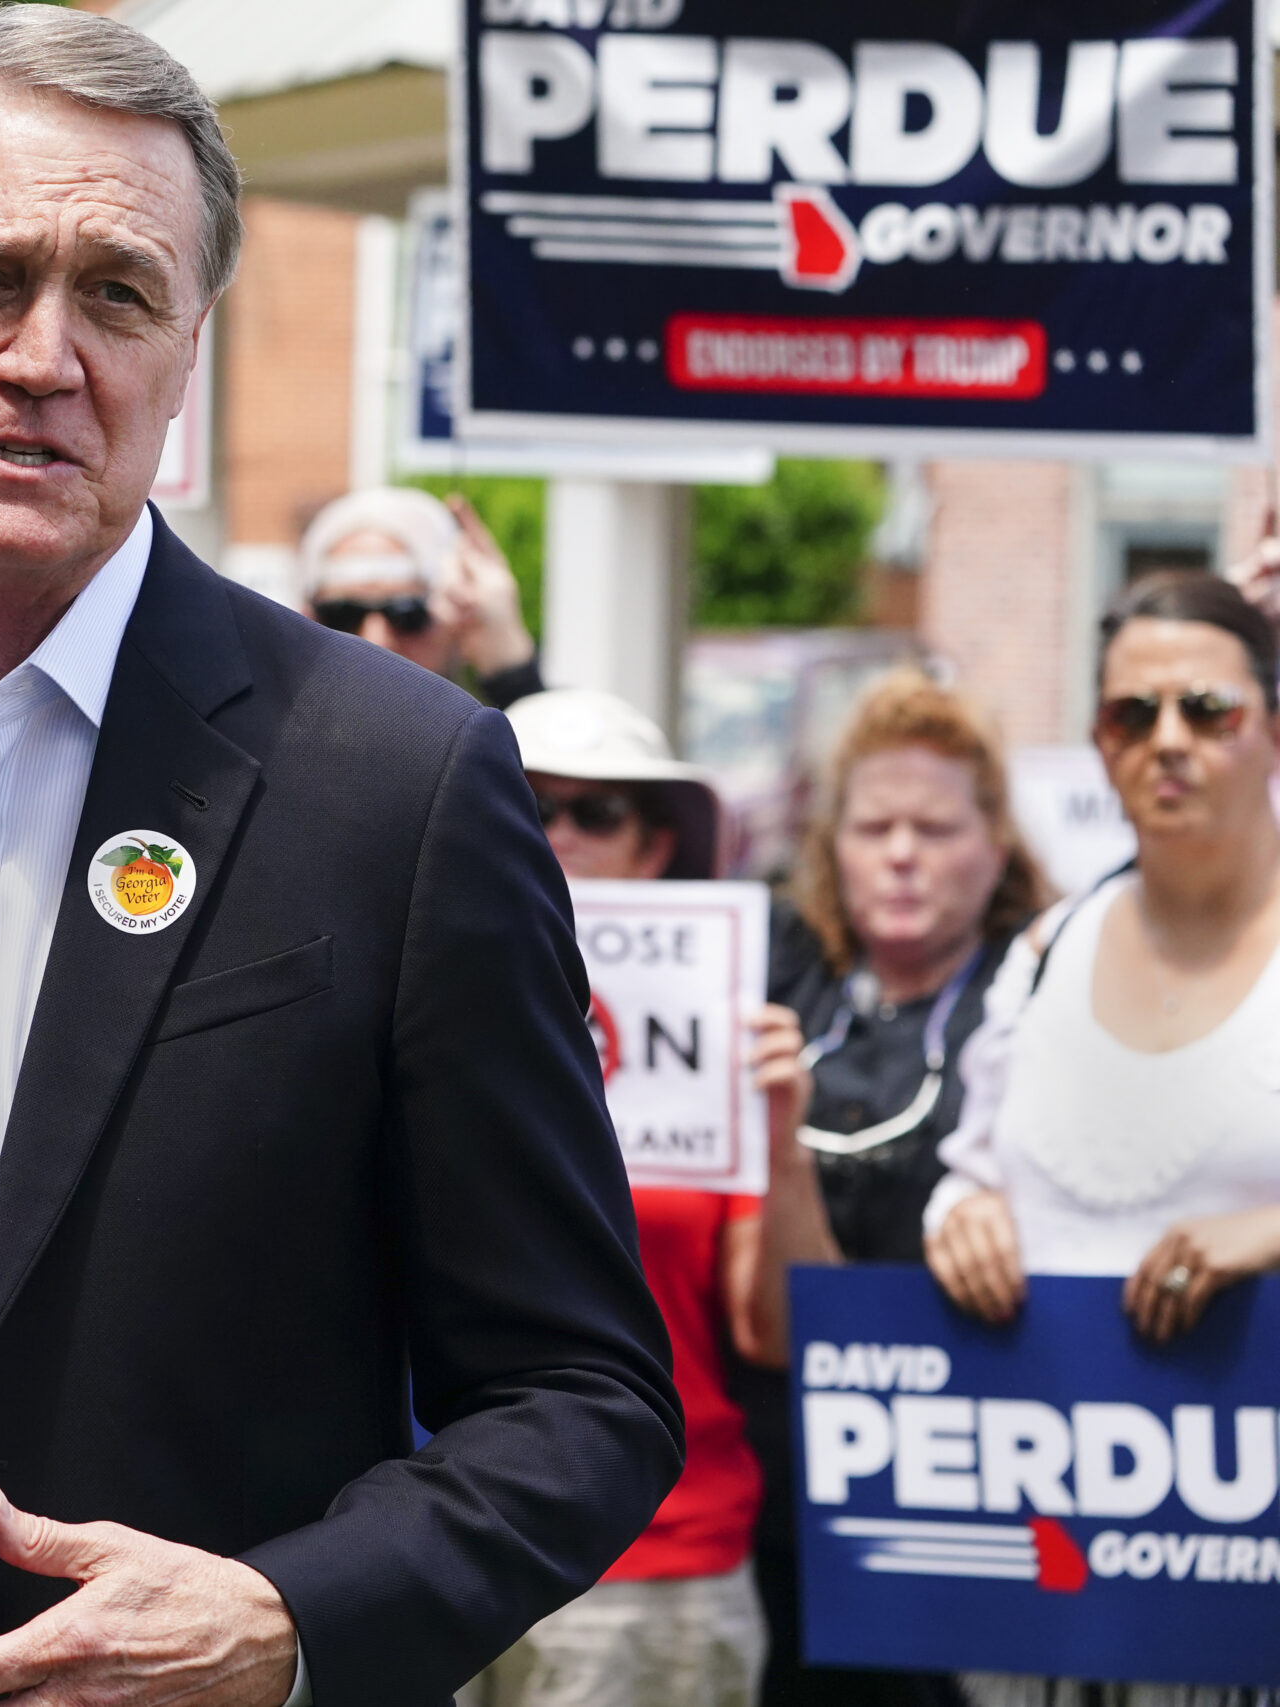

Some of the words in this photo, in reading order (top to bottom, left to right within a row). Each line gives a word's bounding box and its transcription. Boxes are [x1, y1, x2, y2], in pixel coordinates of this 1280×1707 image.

[480, 34, 1238, 186] PERDUE
[860, 203, 1232, 263] GOVERNOR
[685, 329, 854, 381] ENDORSED
[860, 334, 906, 384] BY
[913, 333, 1030, 386] TRUMP
[116, 876, 167, 893] Georgia
[128, 866, 144, 875] I'm
[95, 889, 138, 929] SECURED
[140, 917, 158, 929] MY
[160, 894, 187, 921] VOTE!
[125, 892, 160, 904] Voter
[576, 924, 697, 964] OSE
[803, 1342, 951, 1393] DAVID
[803, 1390, 1280, 1524] PERDU
